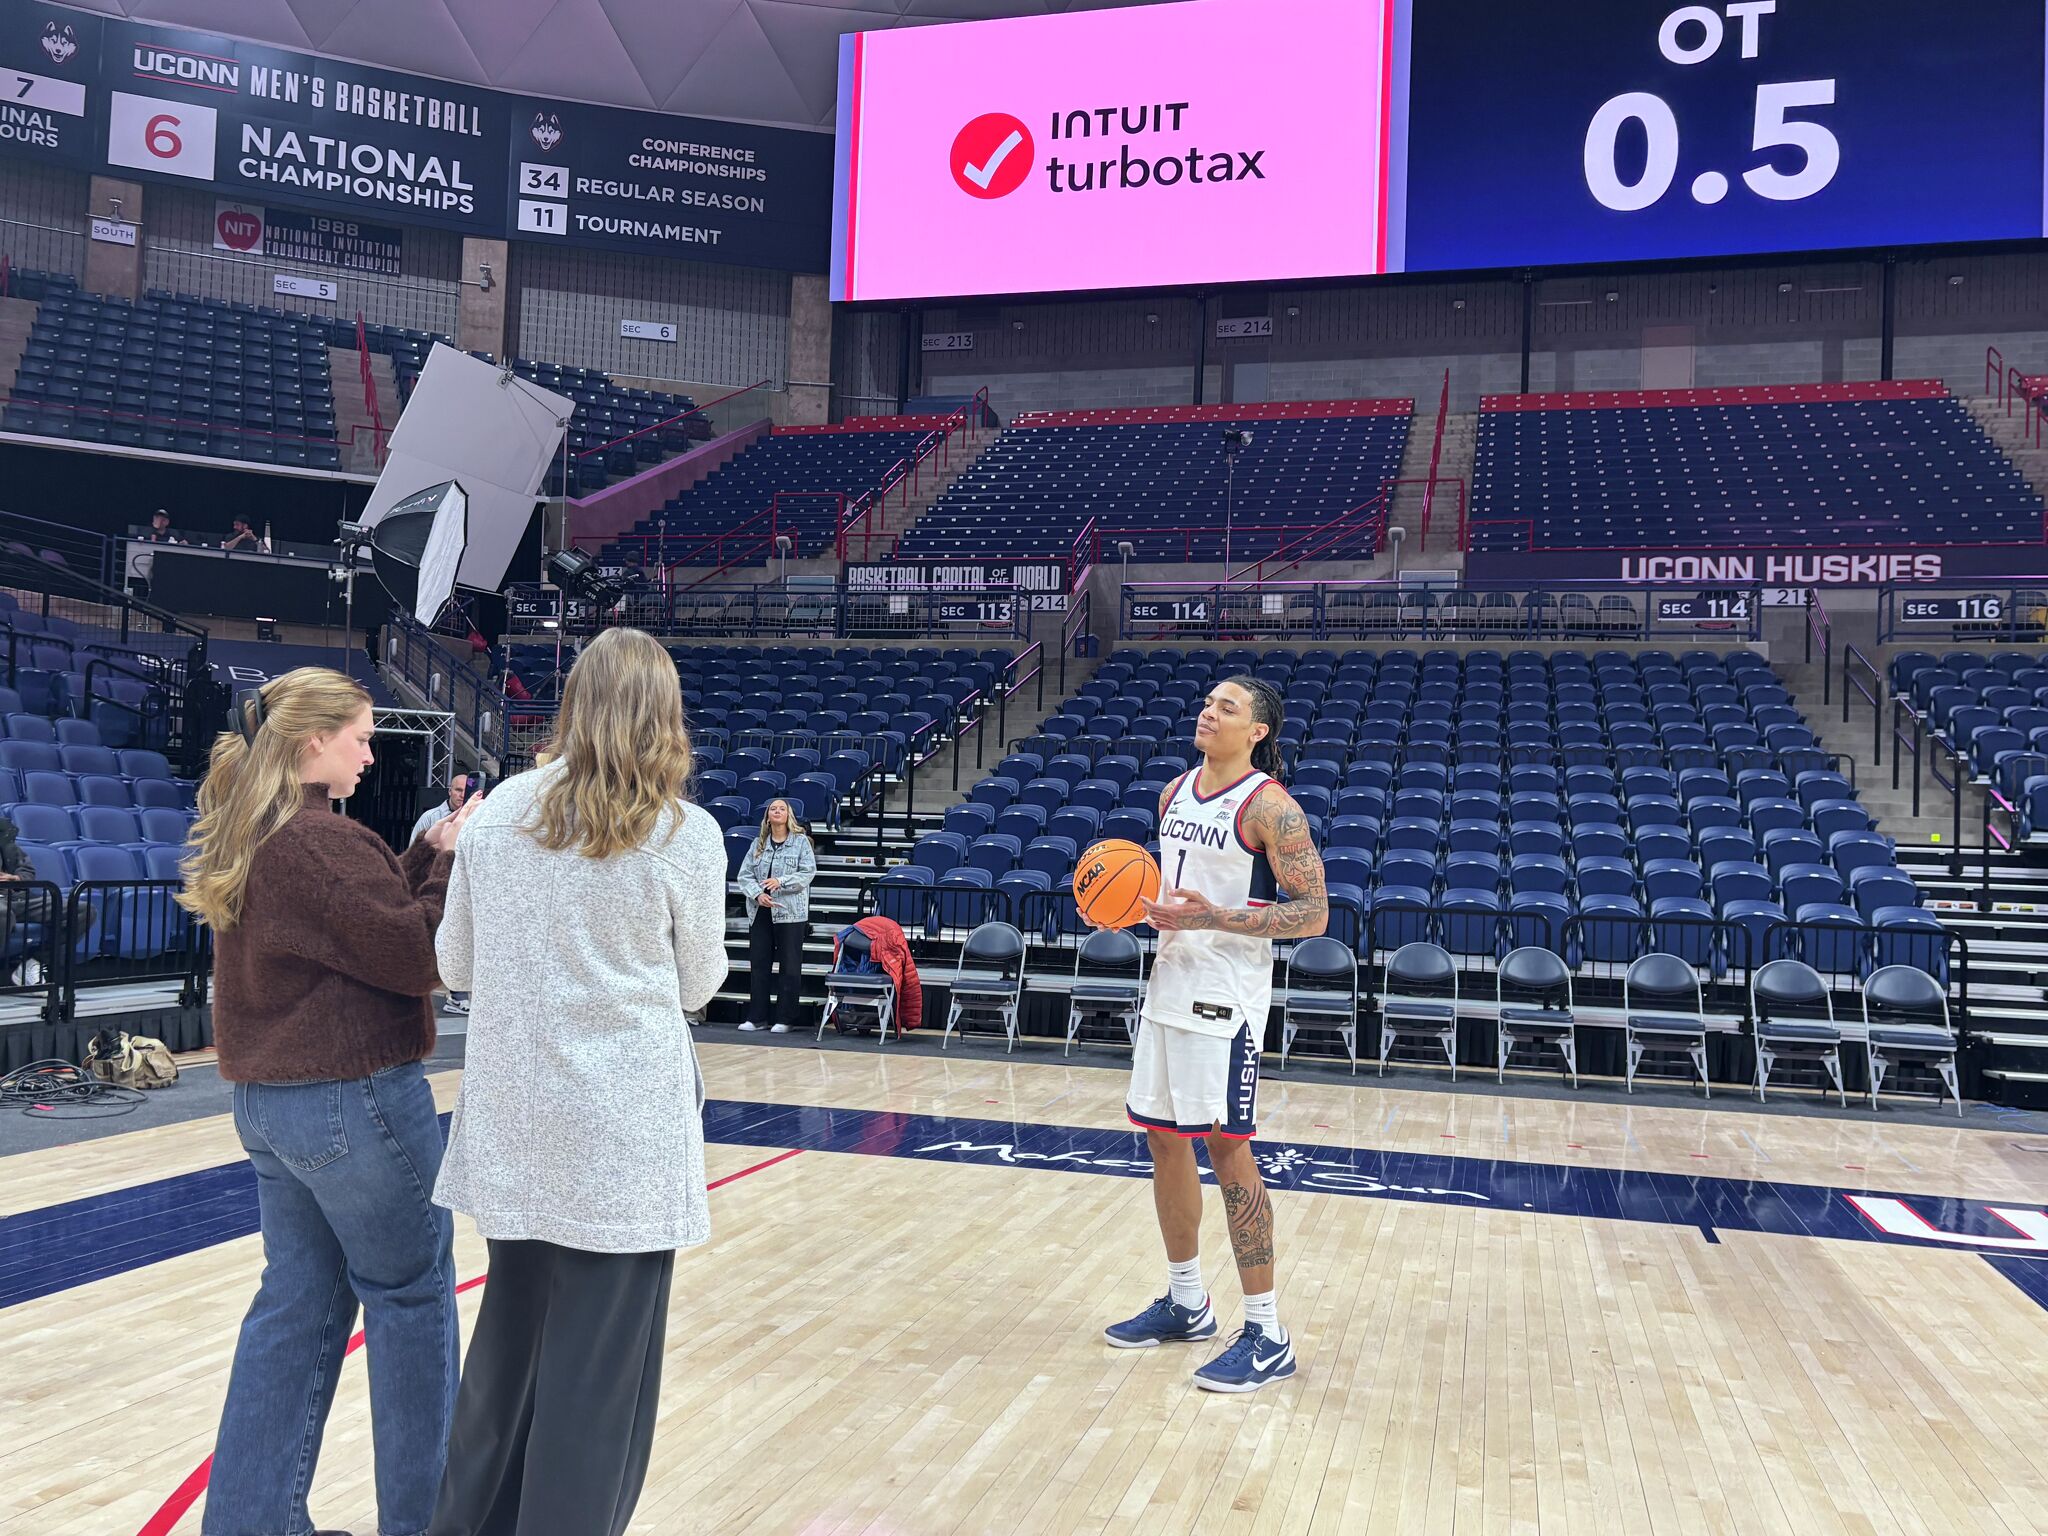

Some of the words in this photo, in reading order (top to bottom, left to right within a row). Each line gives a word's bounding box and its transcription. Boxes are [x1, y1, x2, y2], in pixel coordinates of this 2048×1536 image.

[1658, 0, 1776, 65] OT
[17, 76, 34, 98] 7
[133, 48, 239, 87] UCONN
[250, 65, 325, 108] MEN'S
[335, 80, 482, 137] BASKETBALL
[145, 114, 183, 159] 6
[642, 138, 755, 163] CONFERENCE
[1584, 79, 1840, 212] 0.5
[241, 123, 474, 192] NATIONAL
[628, 154, 767, 182] CHAMPIONSHIPS
[1046, 144, 1266, 193] turbotax
[238, 158, 474, 214] CHAMPIONSHIPS
[527, 169, 560, 191] 34
[576, 177, 675, 203] REGULAR
[681, 189, 765, 213] SEASON
[93, 225, 135, 240] SOUTH
[224, 218, 256, 238] NIT
[310, 216, 359, 237] 1988
[533, 207, 554, 228] 11
[575, 214, 722, 245] TOURNAMENT
[265, 224, 324, 247] NATIONAL
[332, 235, 400, 259] INVITATION
[265, 240, 339, 264] TOURNAMENT
[344, 252, 400, 274] CHAMPION
[275, 279, 297, 291] SEC
[319, 284, 329, 296] 5
[622, 324, 641, 334] SEC
[660, 326, 670, 338] 6
[922, 338, 940, 347] SEC
[947, 335, 972, 348] 213
[1217, 324, 1237, 334] SEC
[1243, 320, 1272, 335] 214
[848, 566, 928, 591] BASKETBALL
[933, 566, 986, 591] CAPITAL
[991, 568, 1007, 577] OF
[1012, 565, 1060, 591] WORLD
[1622, 556, 1754, 583] UCONN
[1766, 554, 1942, 583] HUSKIES
[516, 603, 537, 613] SEC
[941, 606, 965, 617] SEC
[977, 603, 1011, 620] 113
[1034, 595, 1066, 610] 214
[1133, 606, 1158, 616] SEC
[1172, 602, 1206, 620] 114
[1662, 603, 1692, 614] SEC
[1707, 599, 1747, 618] 114
[1906, 604, 1939, 615] SEC
[1957, 599, 2000, 618] 116
[1161, 817, 1229, 850] UCONN
[1076, 861, 1106, 897] NCAA
[1175, 848, 1187, 889] 1
[1301, 1172, 1490, 1201] Sun
